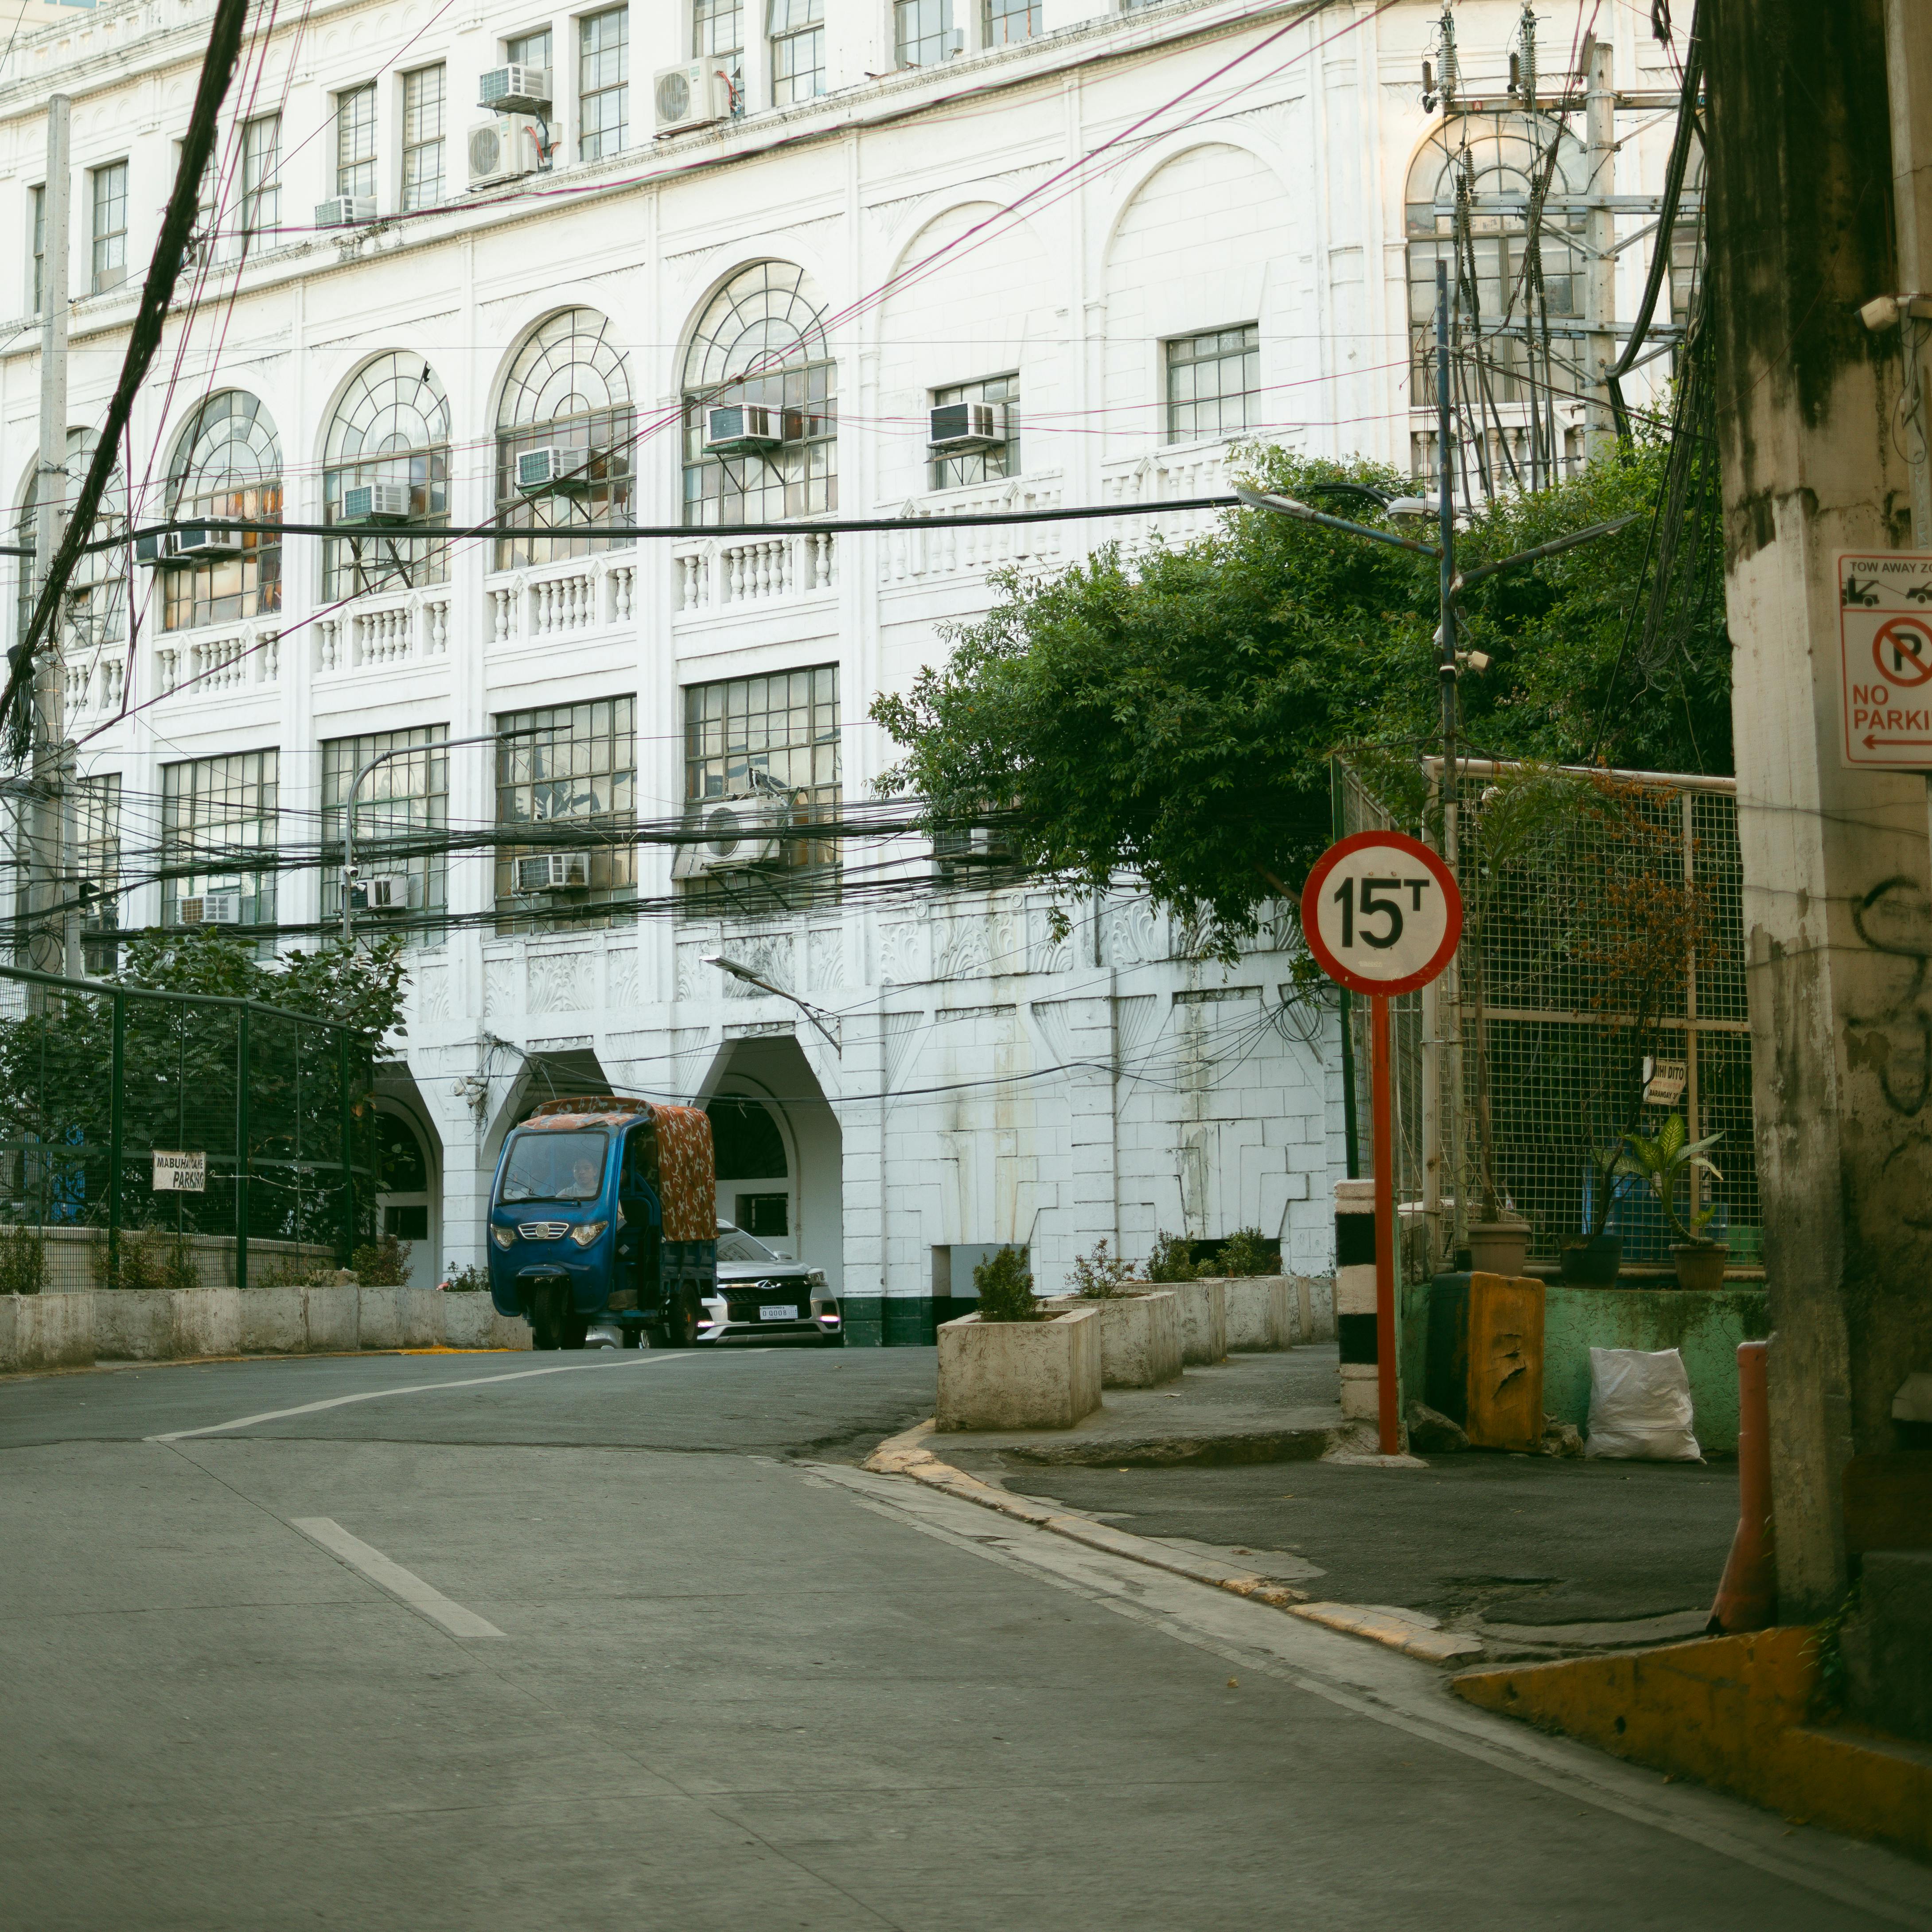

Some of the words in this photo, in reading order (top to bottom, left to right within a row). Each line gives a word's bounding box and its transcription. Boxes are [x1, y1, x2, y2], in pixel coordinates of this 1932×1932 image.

[1850, 561, 1878, 573] TOW
[1881, 562, 1916, 573] AWAY
[1853, 684, 1889, 705] NO
[1668, 1066, 1684, 1080] DITO
[1649, 1089, 1672, 1099] BARANGAY
